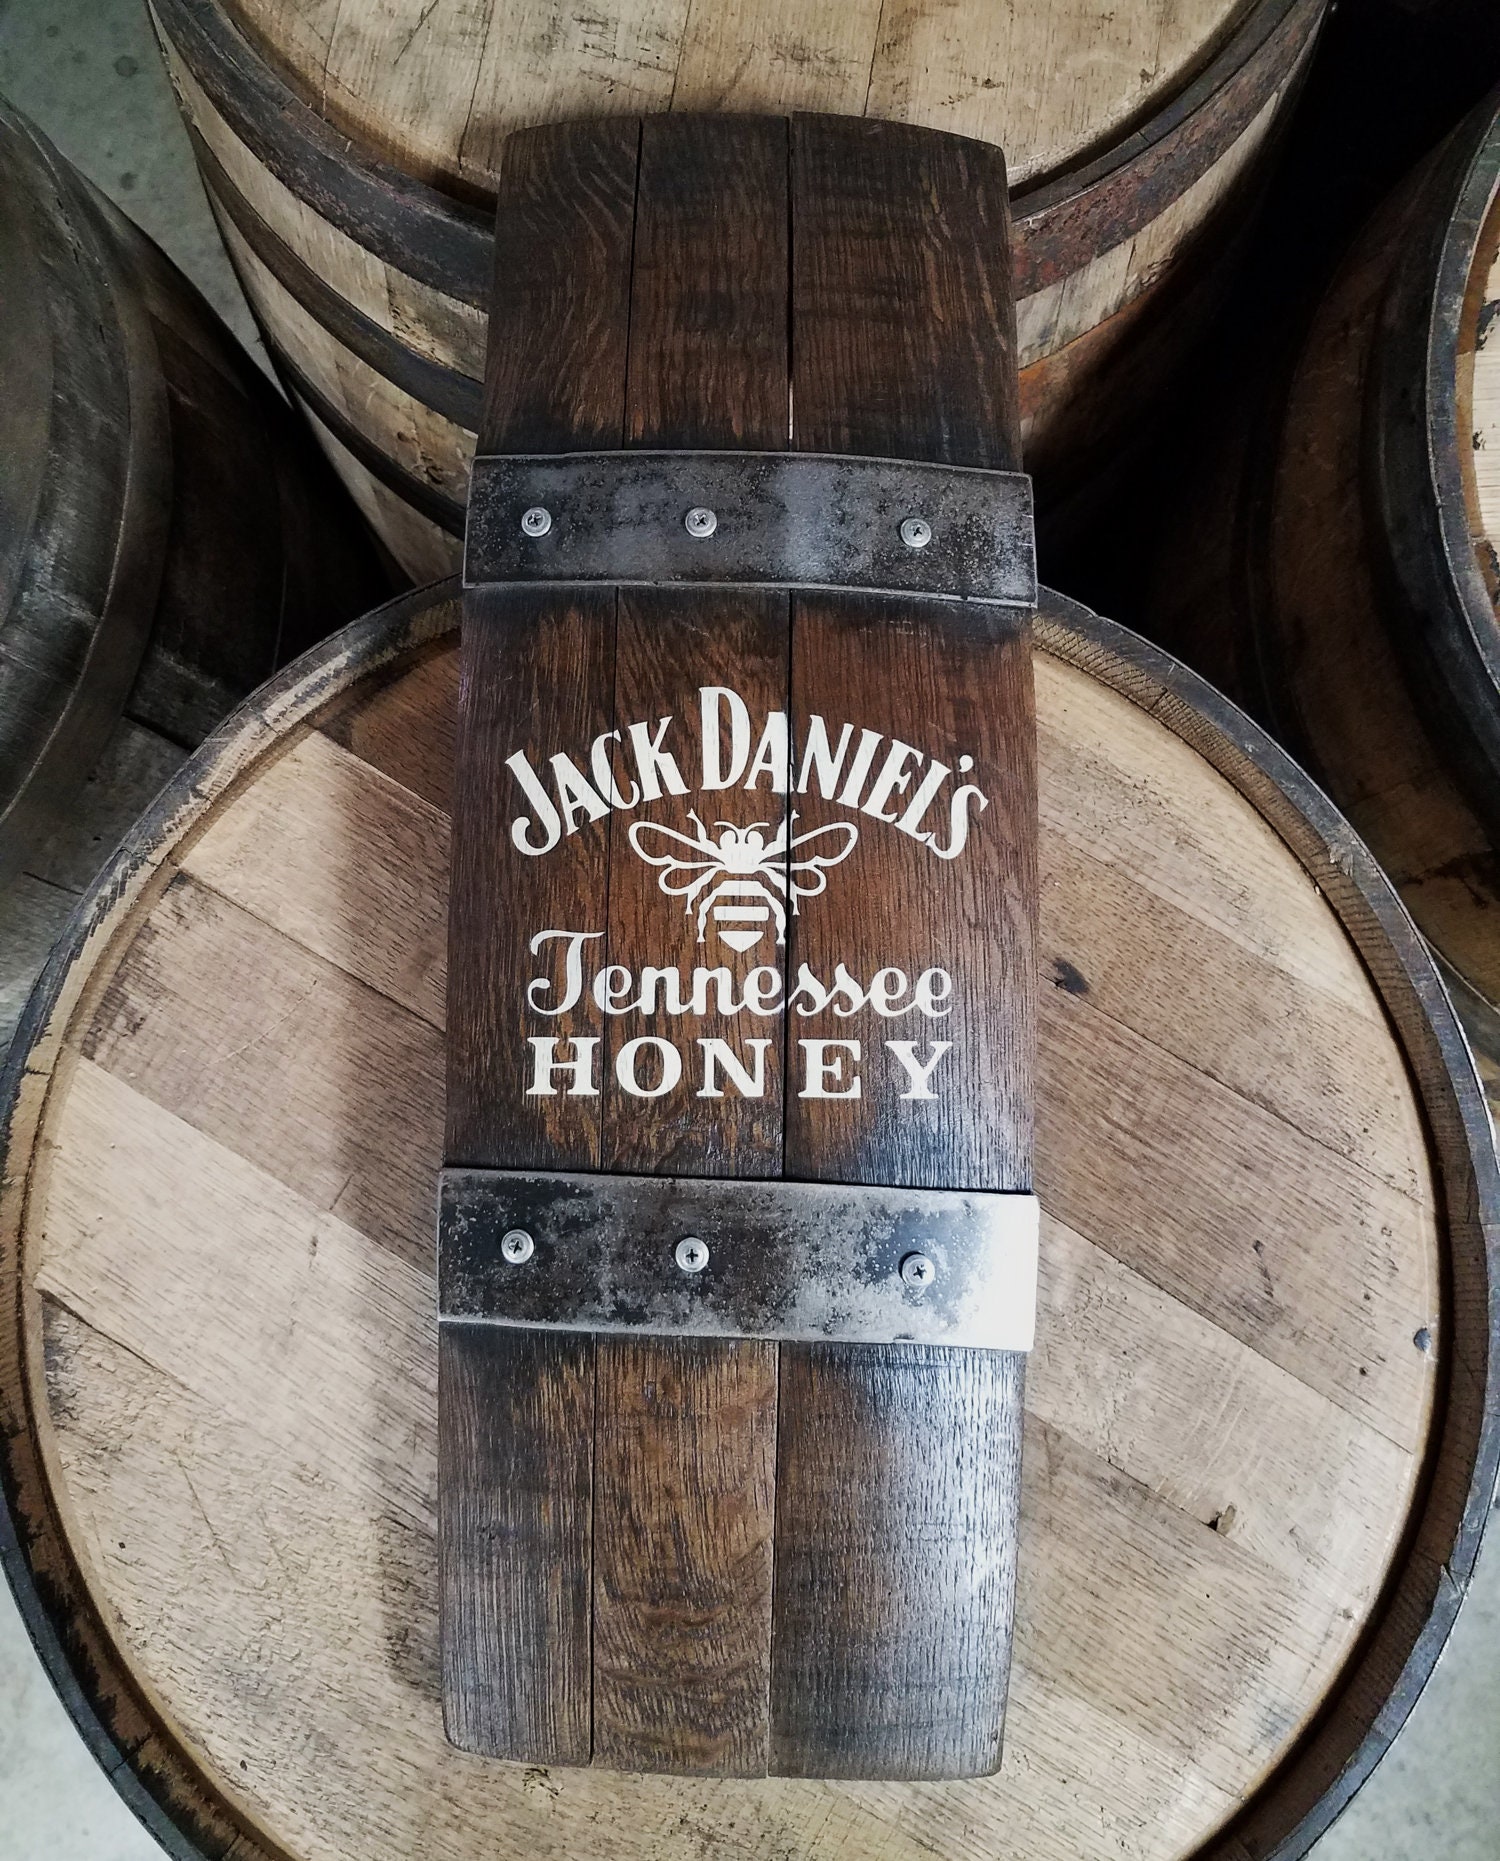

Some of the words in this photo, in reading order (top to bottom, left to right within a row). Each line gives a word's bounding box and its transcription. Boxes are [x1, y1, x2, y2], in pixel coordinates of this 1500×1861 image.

[505, 716, 690, 856] JACK
[699, 686, 989, 860] DANIEL'S
[528, 929, 952, 1017] Tennessee
[526, 1036, 952, 1099] HONEY
